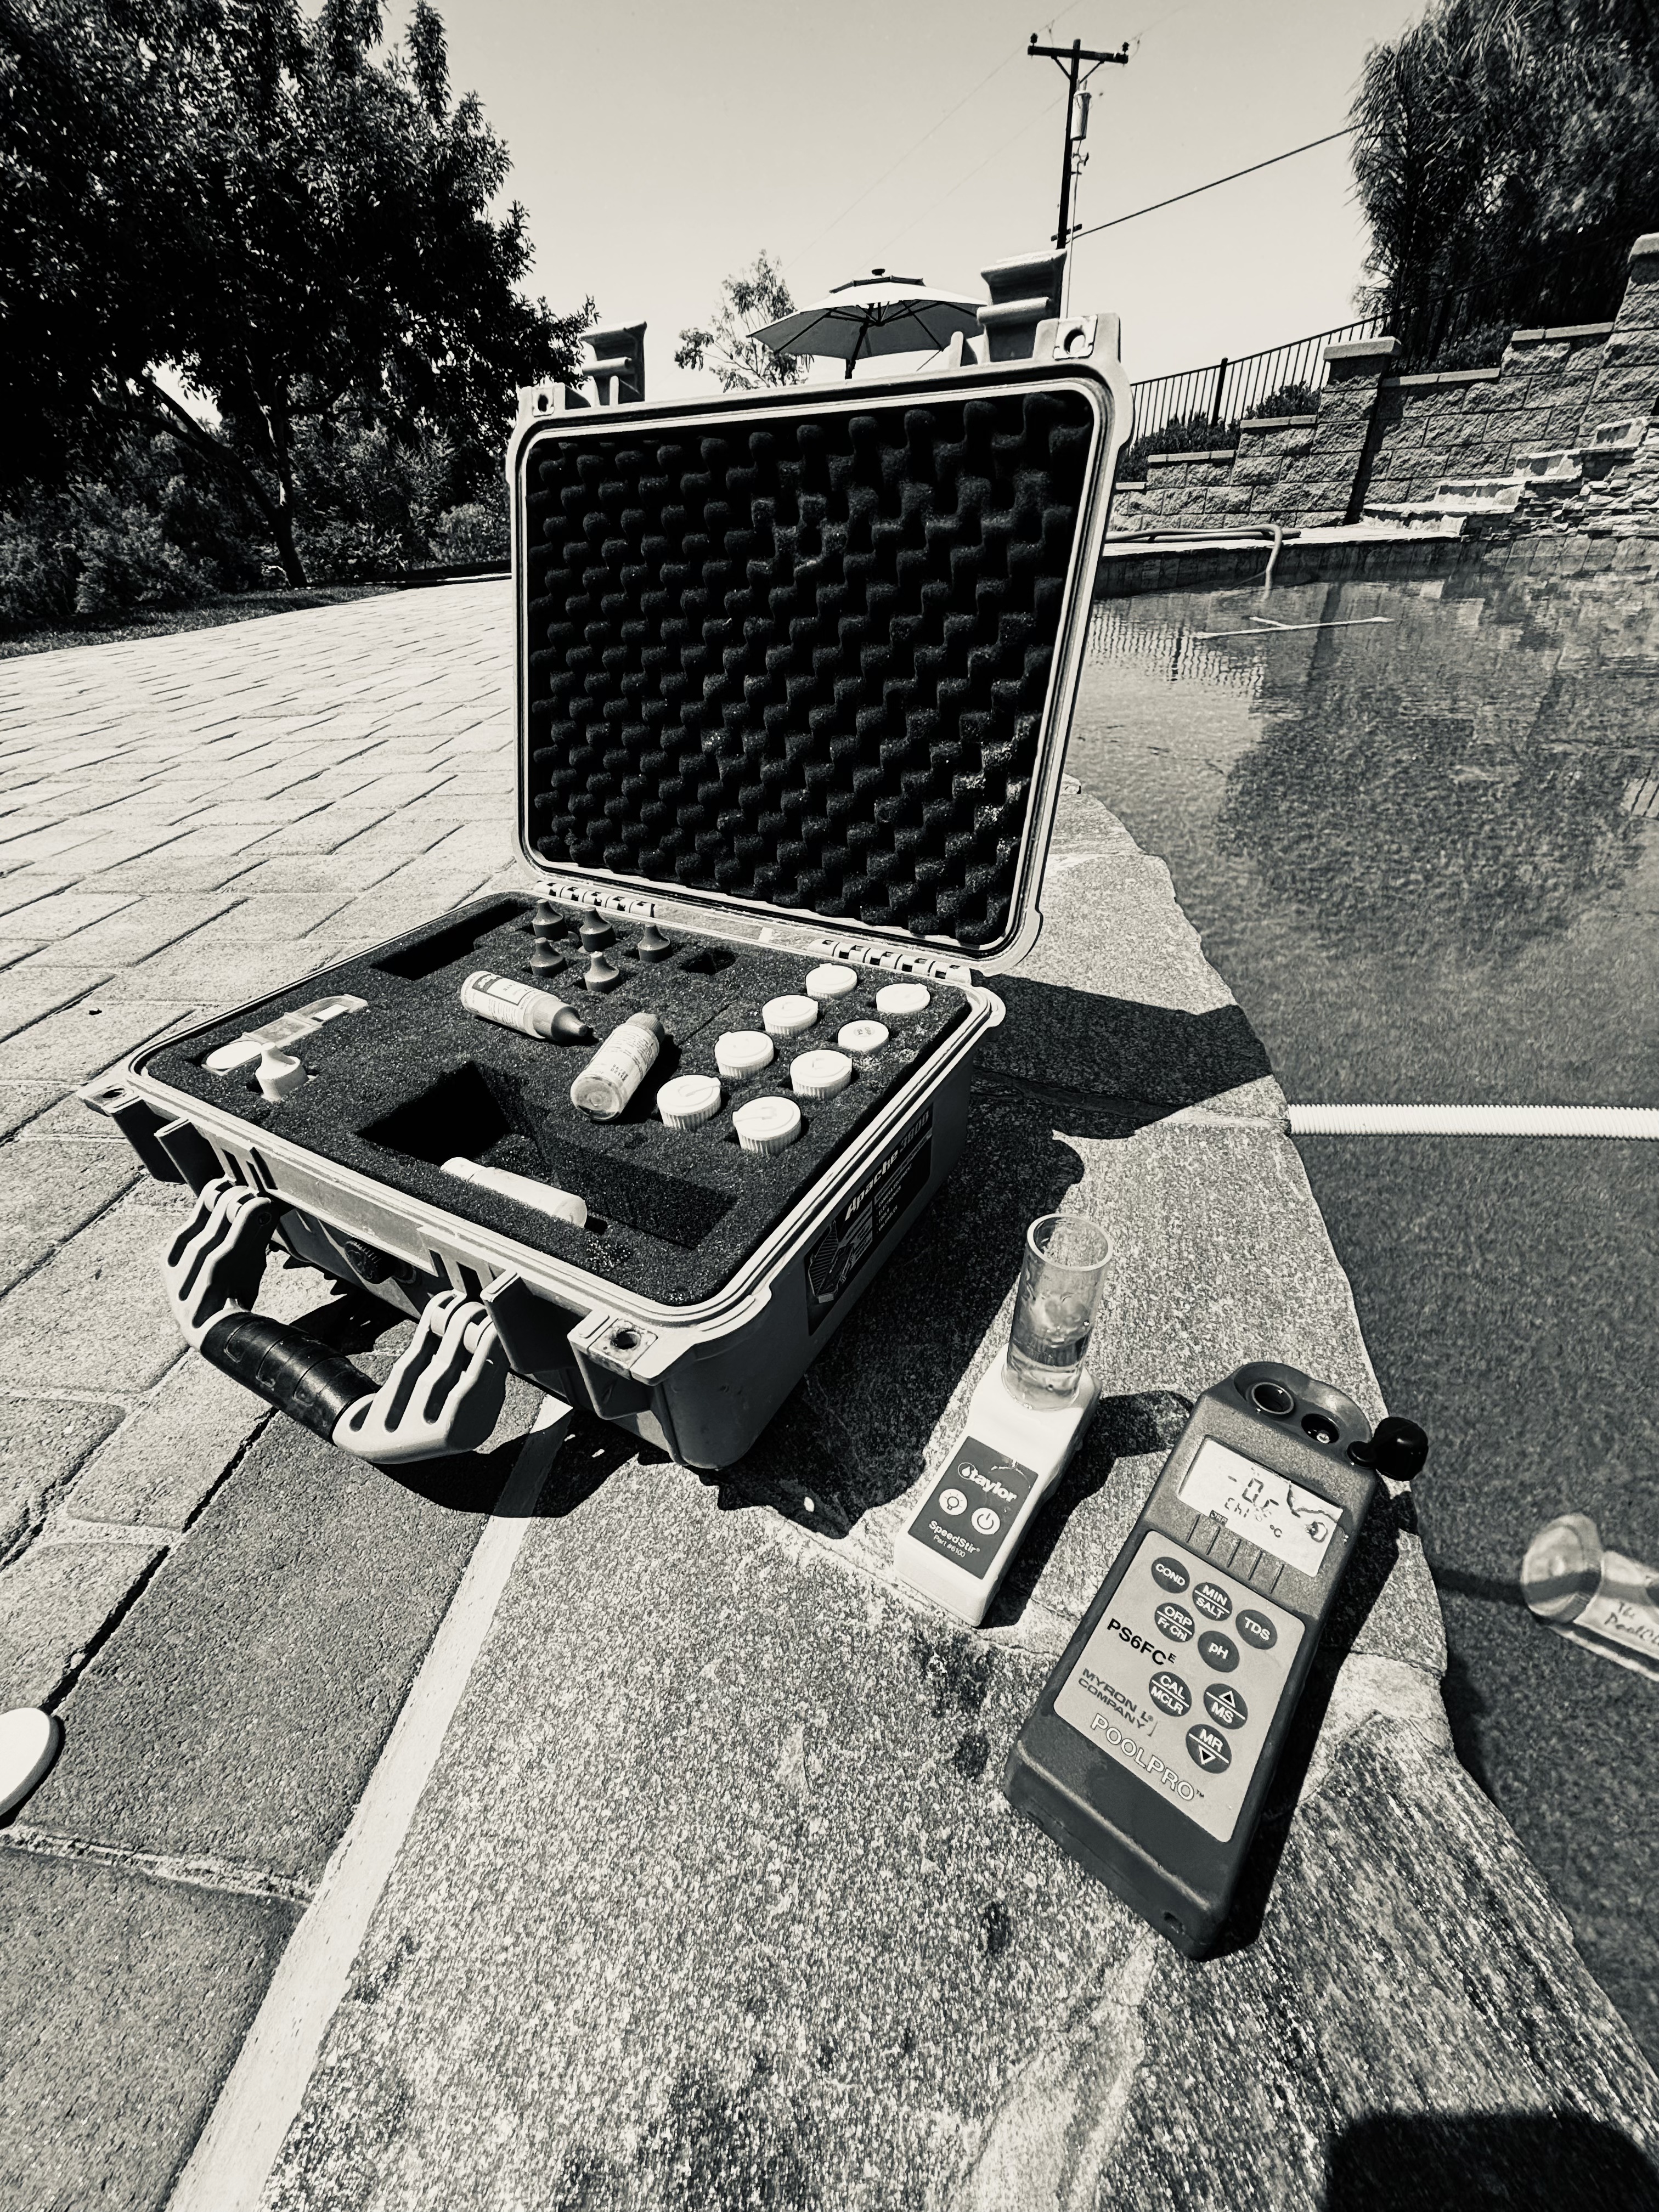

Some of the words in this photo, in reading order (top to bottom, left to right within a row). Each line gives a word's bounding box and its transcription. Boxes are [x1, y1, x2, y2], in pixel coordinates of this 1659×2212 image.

[845, 1150, 898, 1221] Apache
[900, 1109, 929, 1153] 3800
[970, 1468, 1018, 1502] taylor
[933, 1534, 947, 1547] Part
[946, 1542, 966, 1558] #6100
[1155, 1564, 1186, 1586] COND
[1203, 1584, 1228, 1606] MIN
[1164, 1606, 1193, 1626] ORP
[1196, 1597, 1225, 1620] SALT
[1158, 1617, 1170, 1629] Fr
[1170, 1625, 1188, 1641] Chl
[1244, 1616, 1271, 1641] TDS
[1208, 1643, 1229, 1659] pH
[1082, 1668, 1137, 1713] MYRON
[1160, 1675, 1186, 1700] CAL
[1078, 1677, 1146, 1729] COMPANY
[1151, 1686, 1183, 1715] MCLR
[1211, 1702, 1234, 1724] MS
[1199, 1728, 1223, 1752] MR
